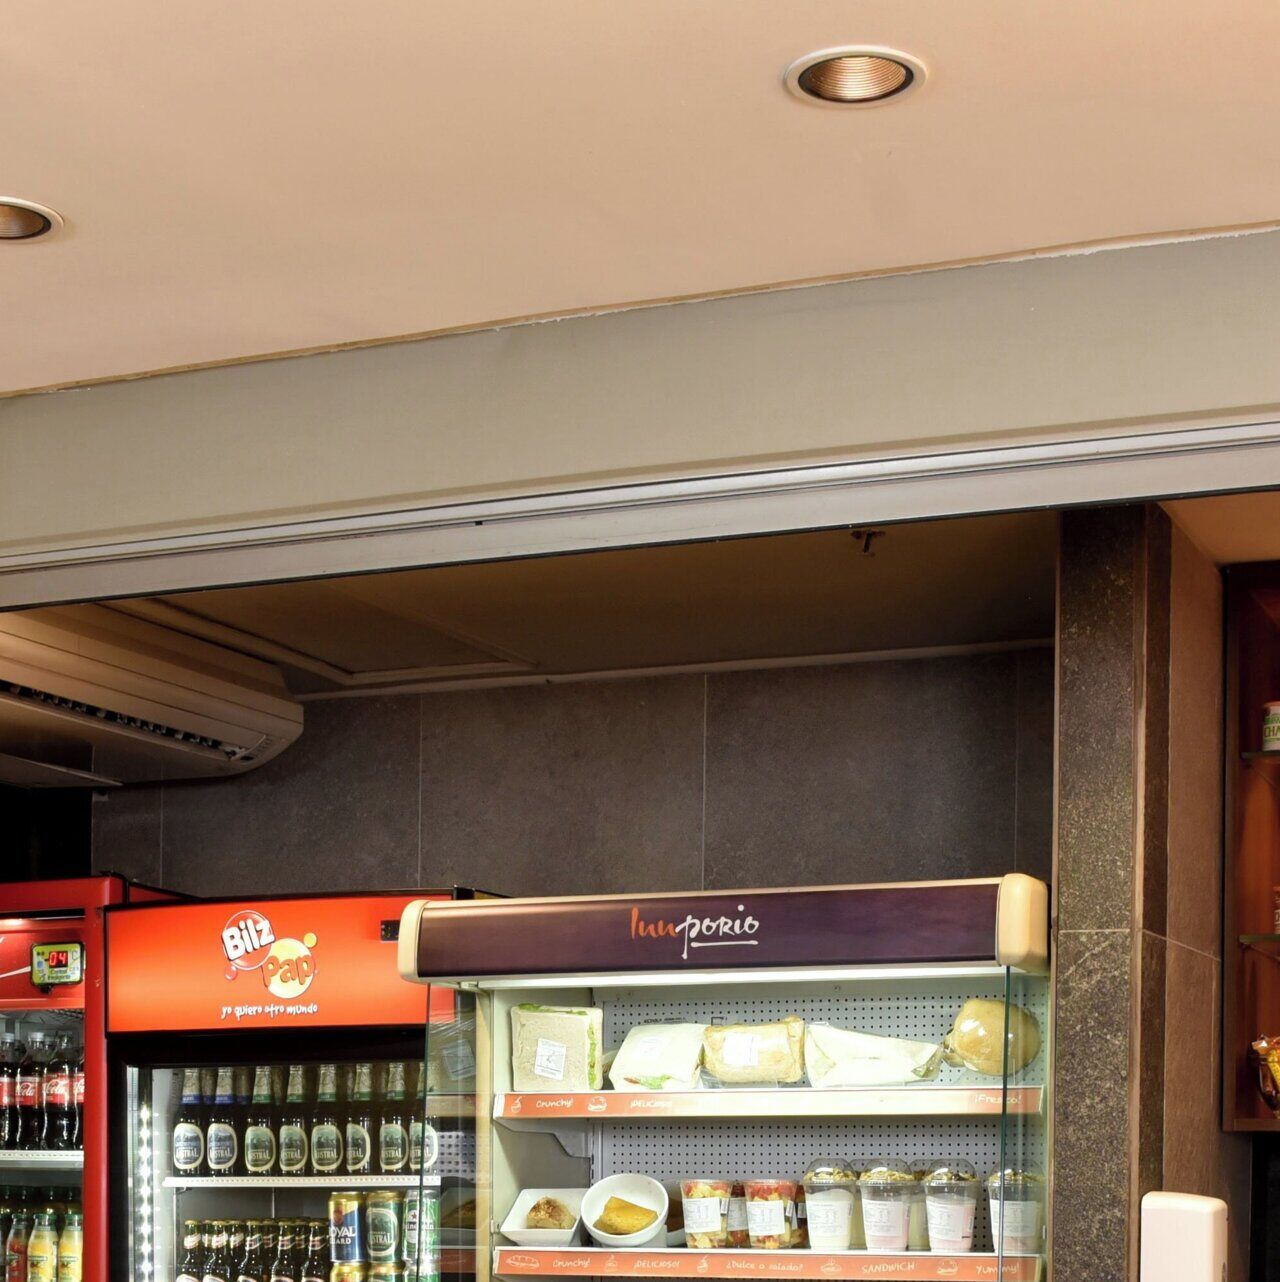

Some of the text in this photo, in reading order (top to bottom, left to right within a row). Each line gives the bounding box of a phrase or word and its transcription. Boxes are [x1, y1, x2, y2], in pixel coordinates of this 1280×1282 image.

[222, 918, 276, 961] Bilz
[221, 1003, 318, 1021] yo quiero otro mundo
[536, 1098, 574, 1109] Crunchy!
[553, 1258, 591, 1269] Crunchy!
[634, 1260, 680, 1270] ¡DELICIOSO!
[862, 1262, 915, 1274] SANDWICH
